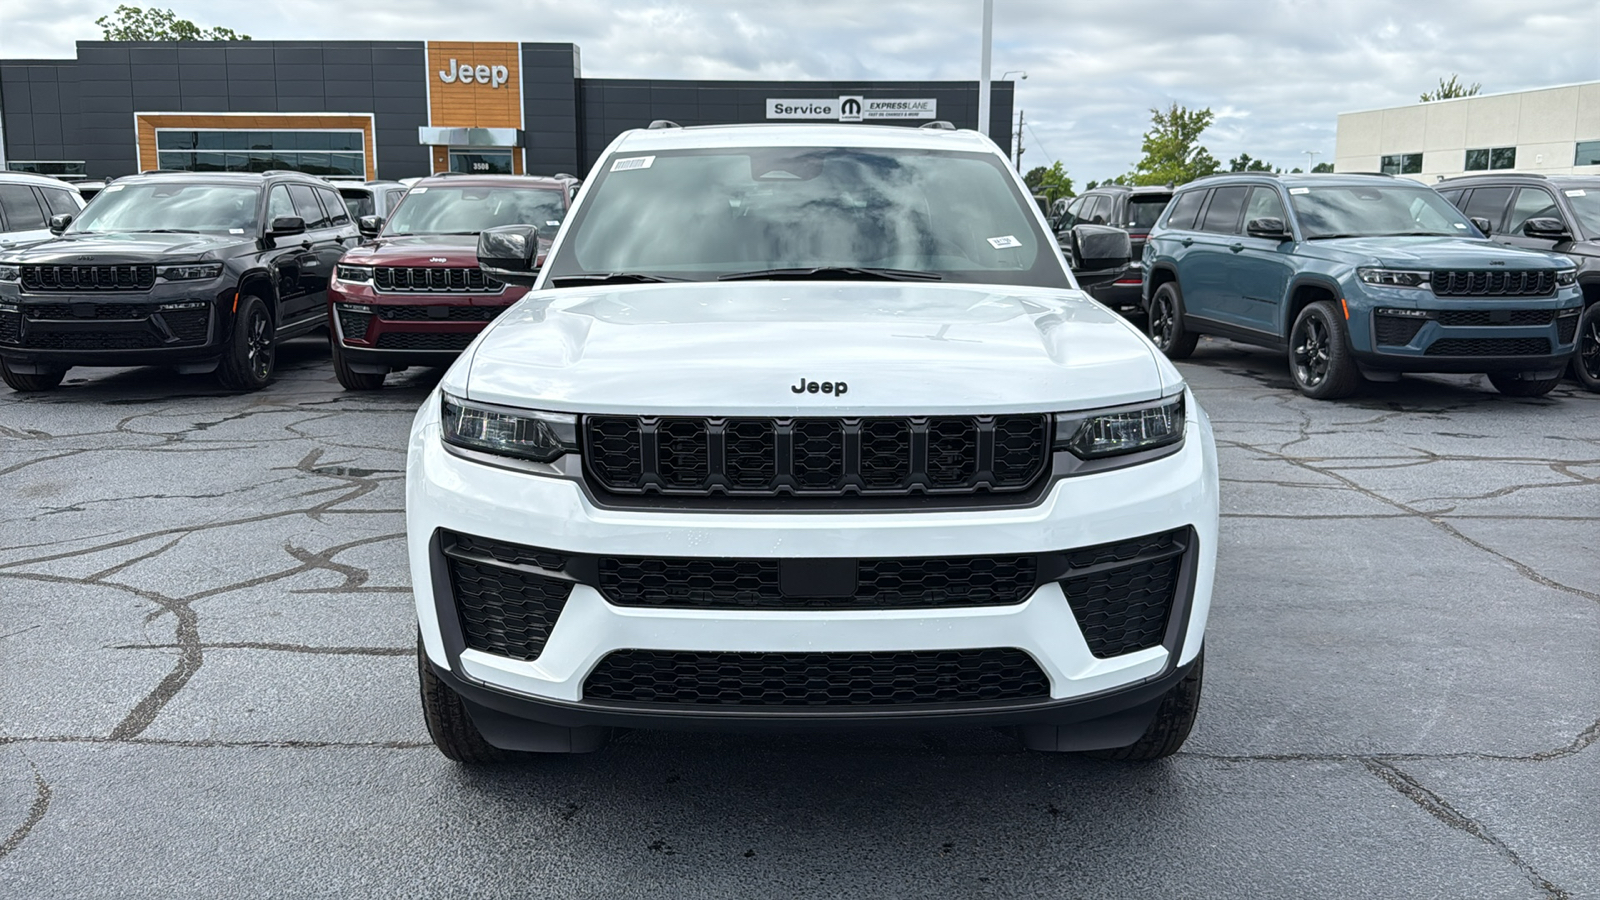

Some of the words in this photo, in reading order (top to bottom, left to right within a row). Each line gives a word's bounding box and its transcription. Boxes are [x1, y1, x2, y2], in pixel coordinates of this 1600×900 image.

[439, 58, 508, 89] Jeep
[774, 103, 832, 115] Service
[791, 377, 848, 397] Jeep
